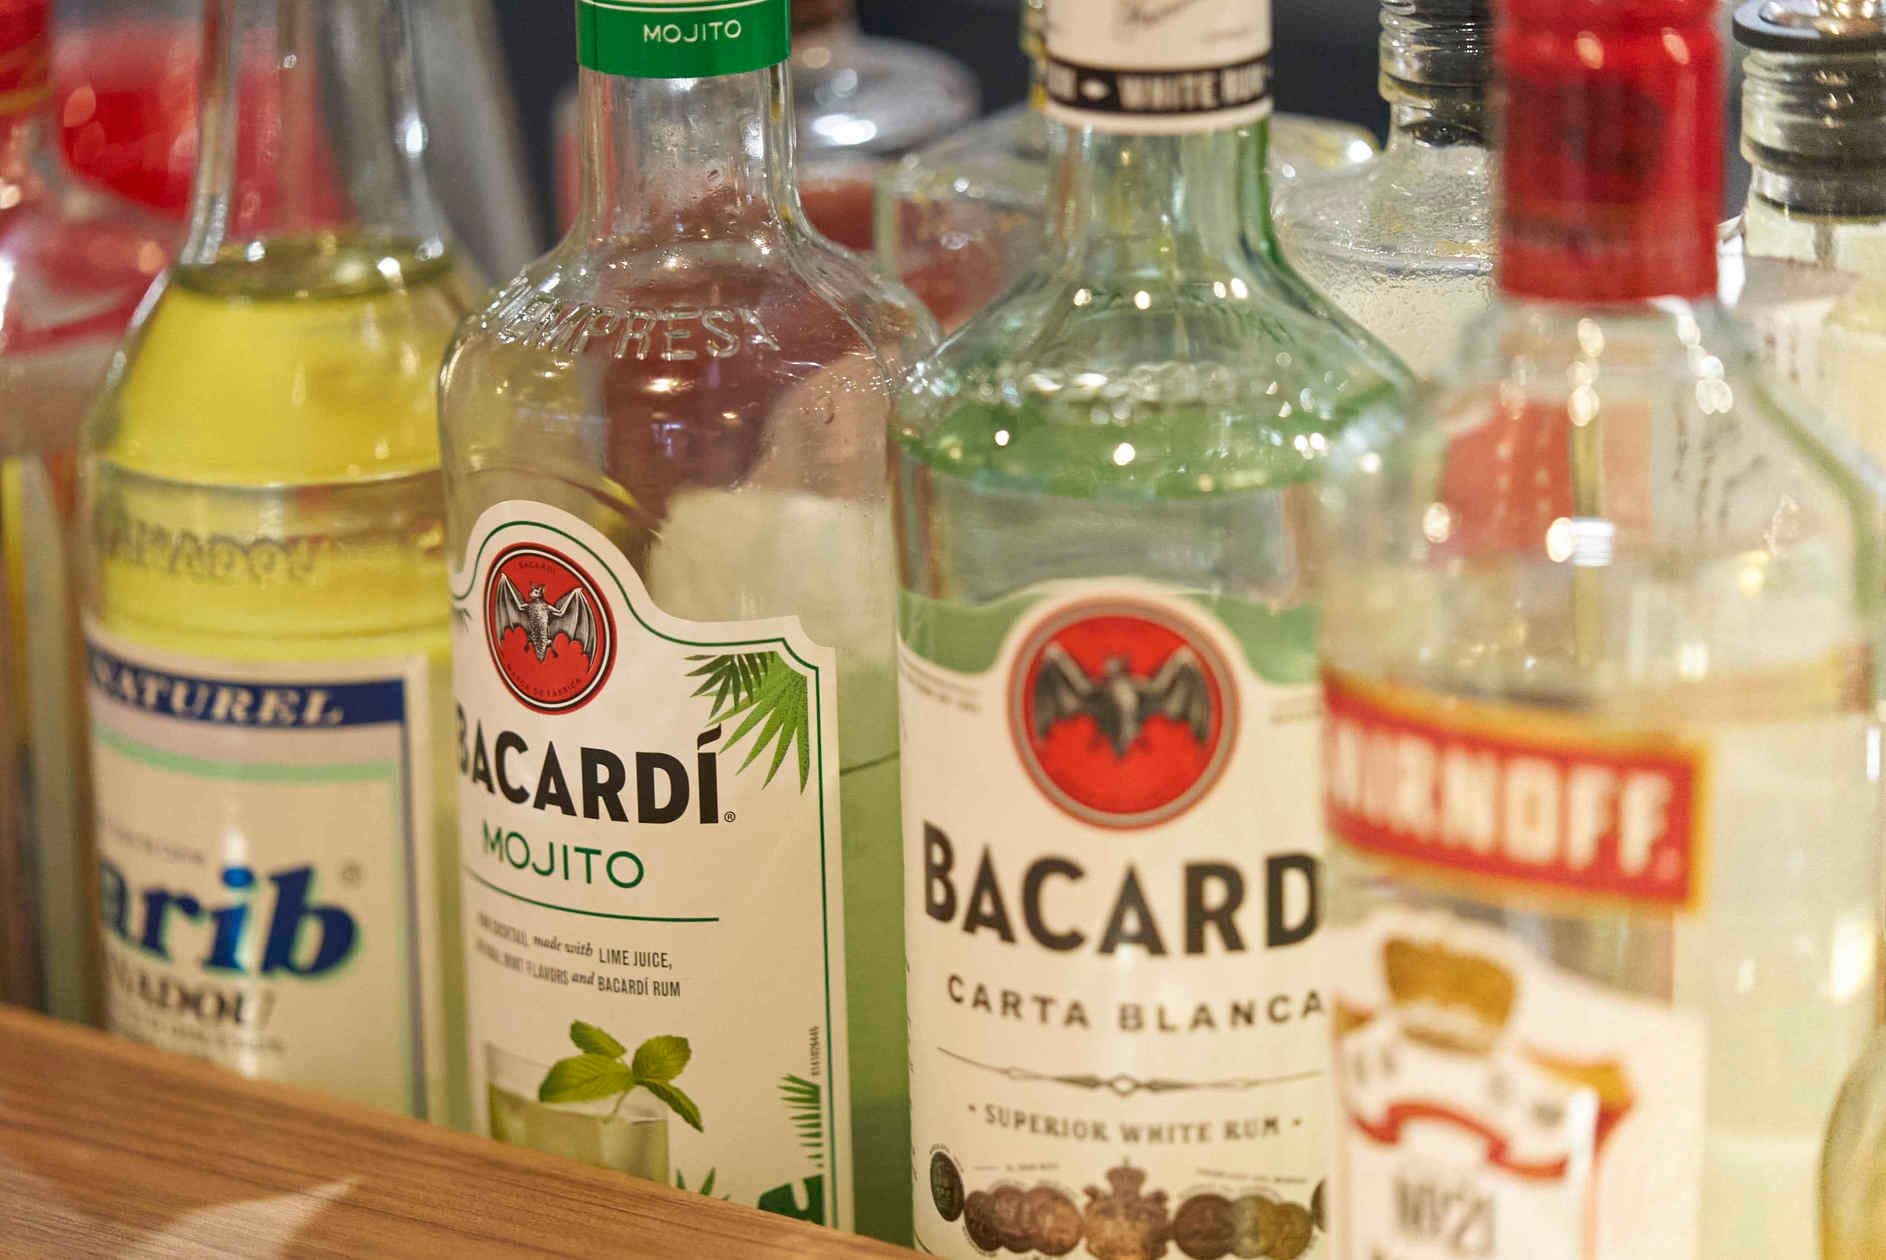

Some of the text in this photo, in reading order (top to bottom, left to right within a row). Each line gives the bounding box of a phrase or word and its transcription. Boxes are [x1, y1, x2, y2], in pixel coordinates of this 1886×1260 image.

[643, 19, 742, 44] MOJITO
[92, 655, 345, 728] NATUREL
[456, 700, 724, 825] BACARDÍ
[483, 818, 645, 889] MOJITO
[534, 935, 562, 952] made
[564, 943, 594, 957] with
[599, 948, 630, 966] LIME
[632, 951, 673, 970] JUICE,
[571, 971, 596, 986] and
[598, 975, 649, 996] BACARDÍ
[652, 981, 681, 997] RUM
[947, 973, 1325, 1033] CARTA BLANCA
[985, 1105, 1281, 1144] SUPERIOR WHITE RUM
